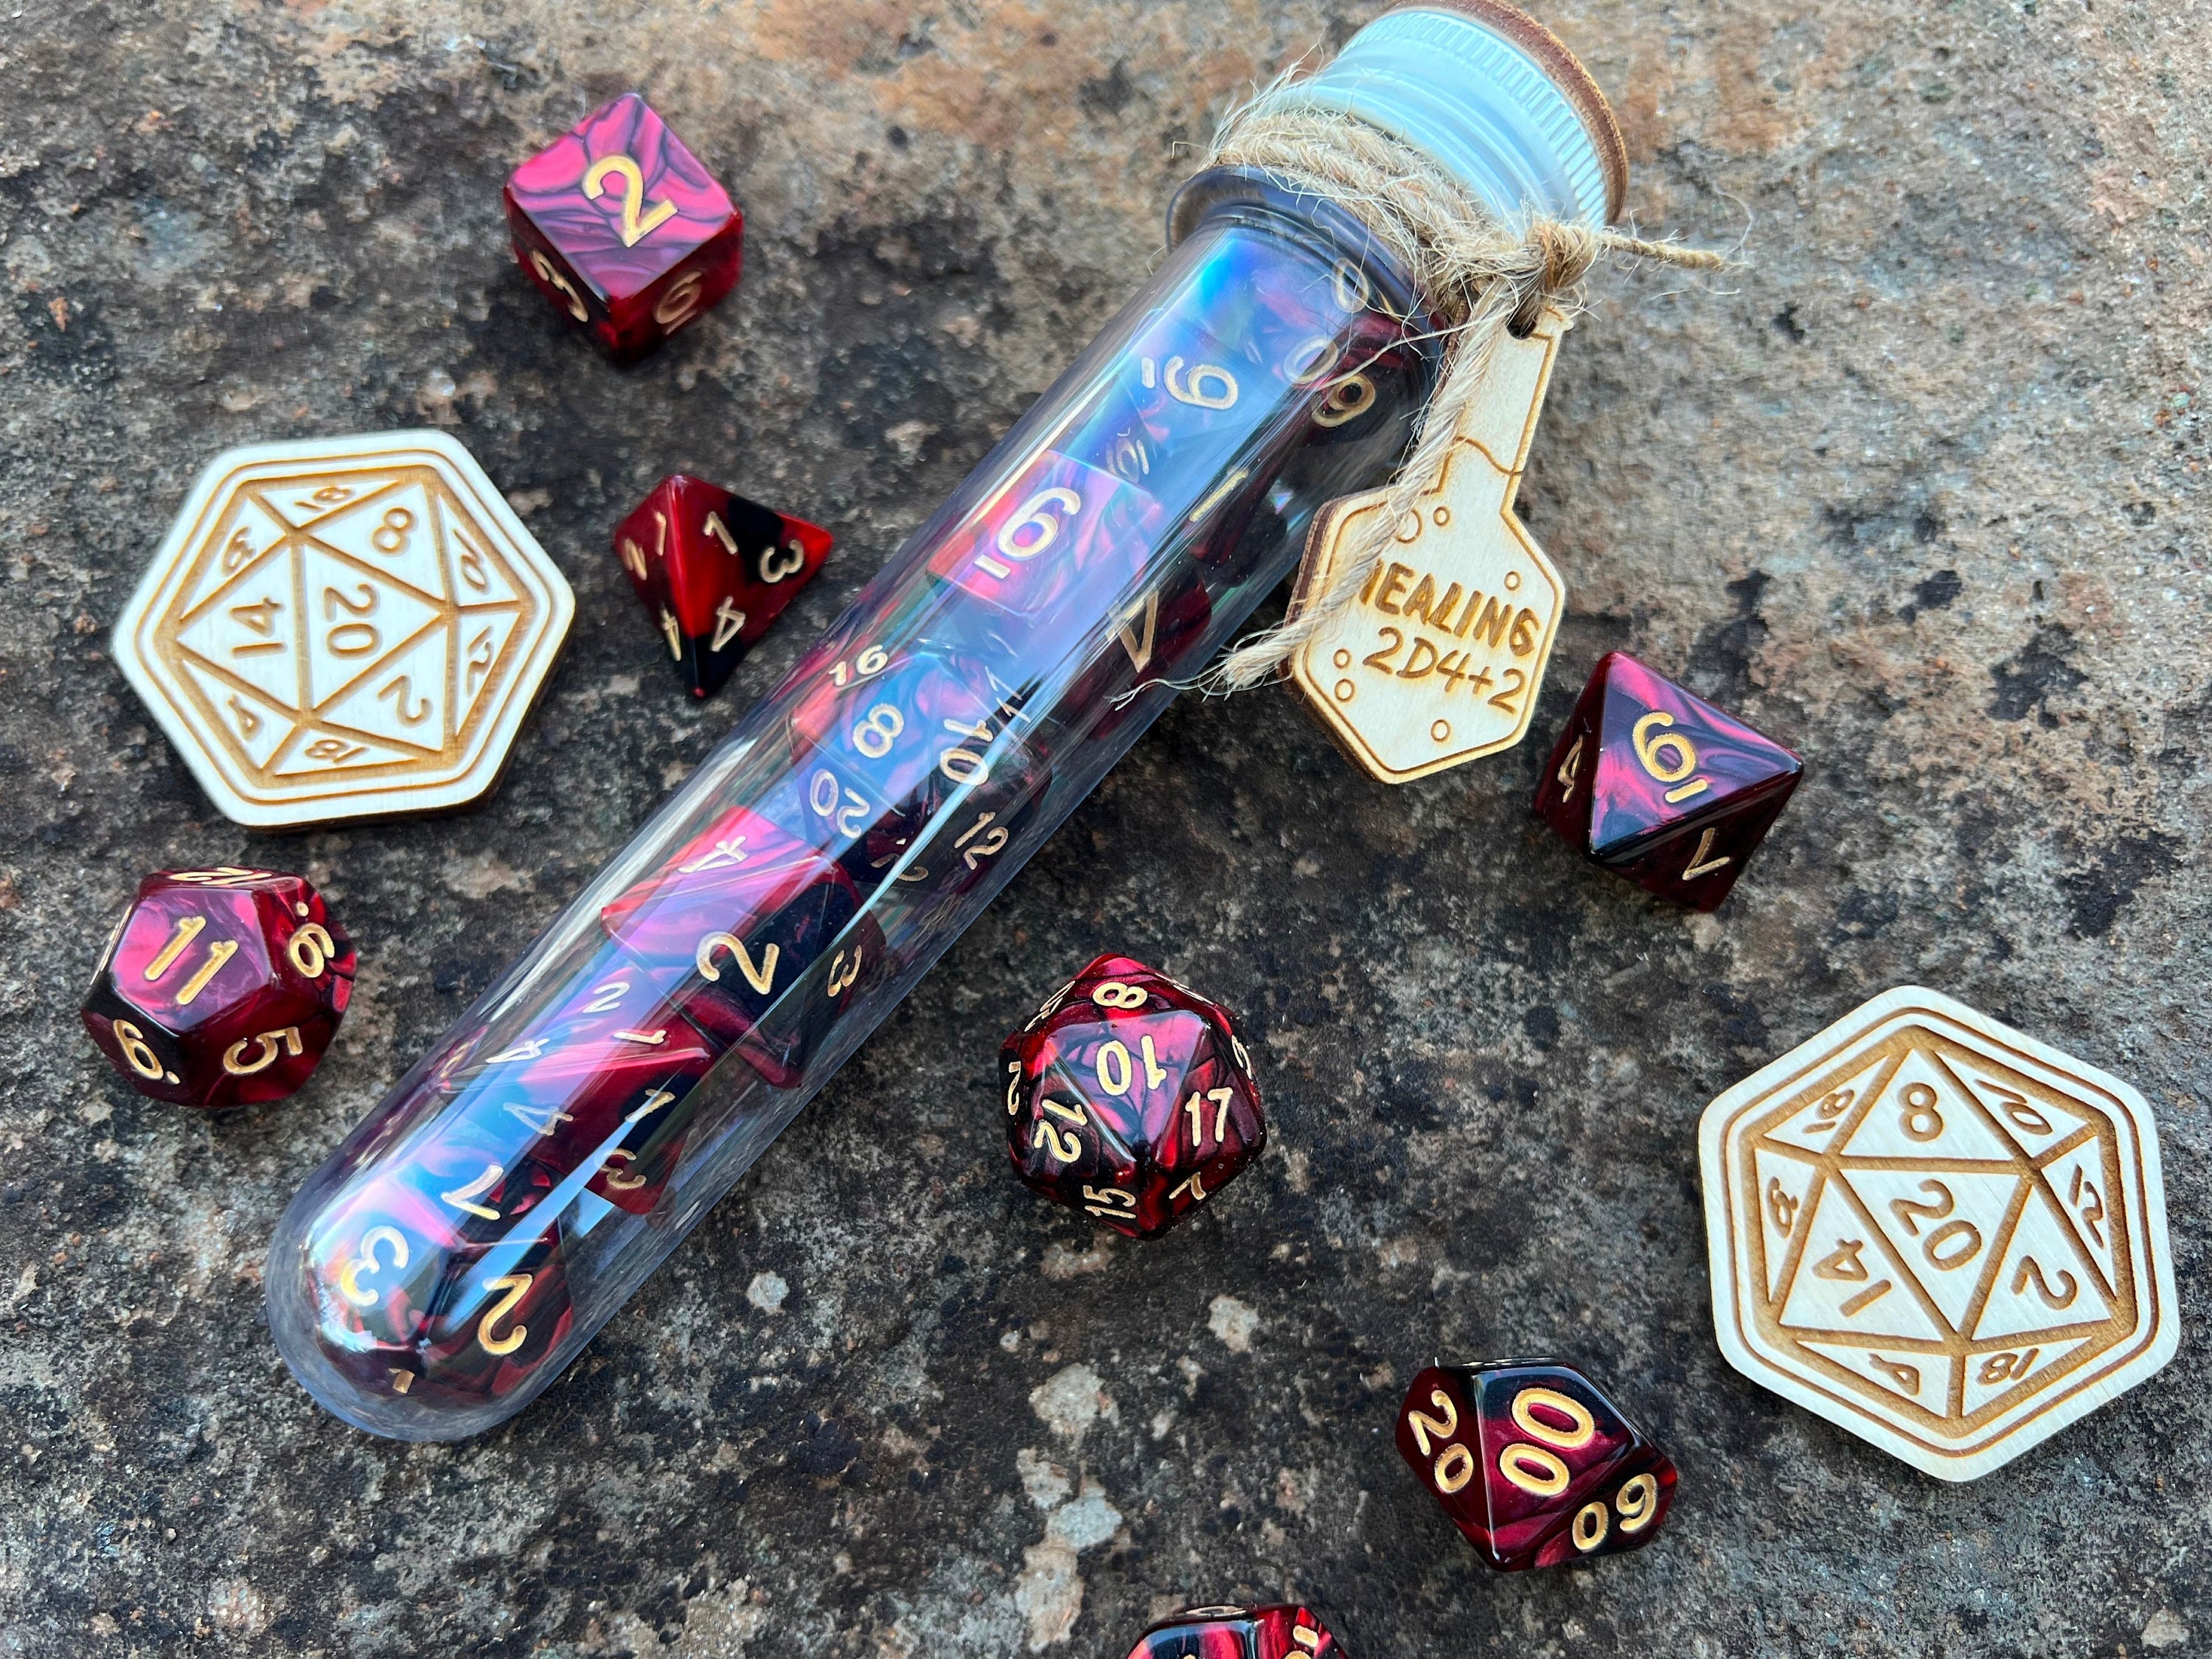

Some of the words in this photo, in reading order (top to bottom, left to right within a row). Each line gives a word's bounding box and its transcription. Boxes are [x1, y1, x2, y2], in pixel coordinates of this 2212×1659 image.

[582, 156, 678, 248] 2
[370, 507, 419, 555] 8
[653, 512, 667, 556] 1
[703, 511, 738, 555] 1
[974, 487, 1081, 580] 6
[760, 540, 804, 583] 3
[229, 597, 286, 659] 14
[323, 584, 382, 658] 20
[661, 605, 681, 661] 4
[711, 596, 745, 652] 4
[829, 644, 888, 686] 16
[1363, 627, 1526, 714] 2D4+2
[378, 675, 433, 726] 2
[304, 738, 369, 765] 18
[853, 703, 904, 758] 8
[940, 719, 993, 786] 10
[1632, 712, 1708, 803] 6
[810, 768, 870, 839] 20
[678, 836, 748, 874] 4
[954, 812, 1009, 870] 12
[145, 916, 239, 1005] 11
[696, 931, 780, 995] 2
[827, 945, 863, 997] 3
[582, 982, 630, 1013] 2
[1092, 981, 1148, 1009] 8
[223, 1026, 303, 1075] 5
[486, 1038, 550, 1063] 4
[1096, 1035, 1167, 1096] 10
[503, 1102, 574, 1135] 4
[1034, 1098, 1088, 1164] 12
[1186, 1087, 1234, 1147] 17
[1898, 1082, 1943, 1142] 8
[1976, 1079, 2052, 1135] 10
[1083, 1185, 1137, 1219] 15
[1890, 1179, 1982, 1270] 20
[2069, 1164, 2104, 1248] 12
[341, 1226, 409, 1307] 3
[1812, 1239, 1892, 1316] 14
[2010, 1256, 2077, 1310] 2
[478, 1274, 532, 1356] 2
[1868, 1353, 1919, 1394] 4
[1976, 1347, 2039, 1385] 18
[1408, 1389, 1474, 1495] 20
[1500, 1388, 1595, 1497] 00
